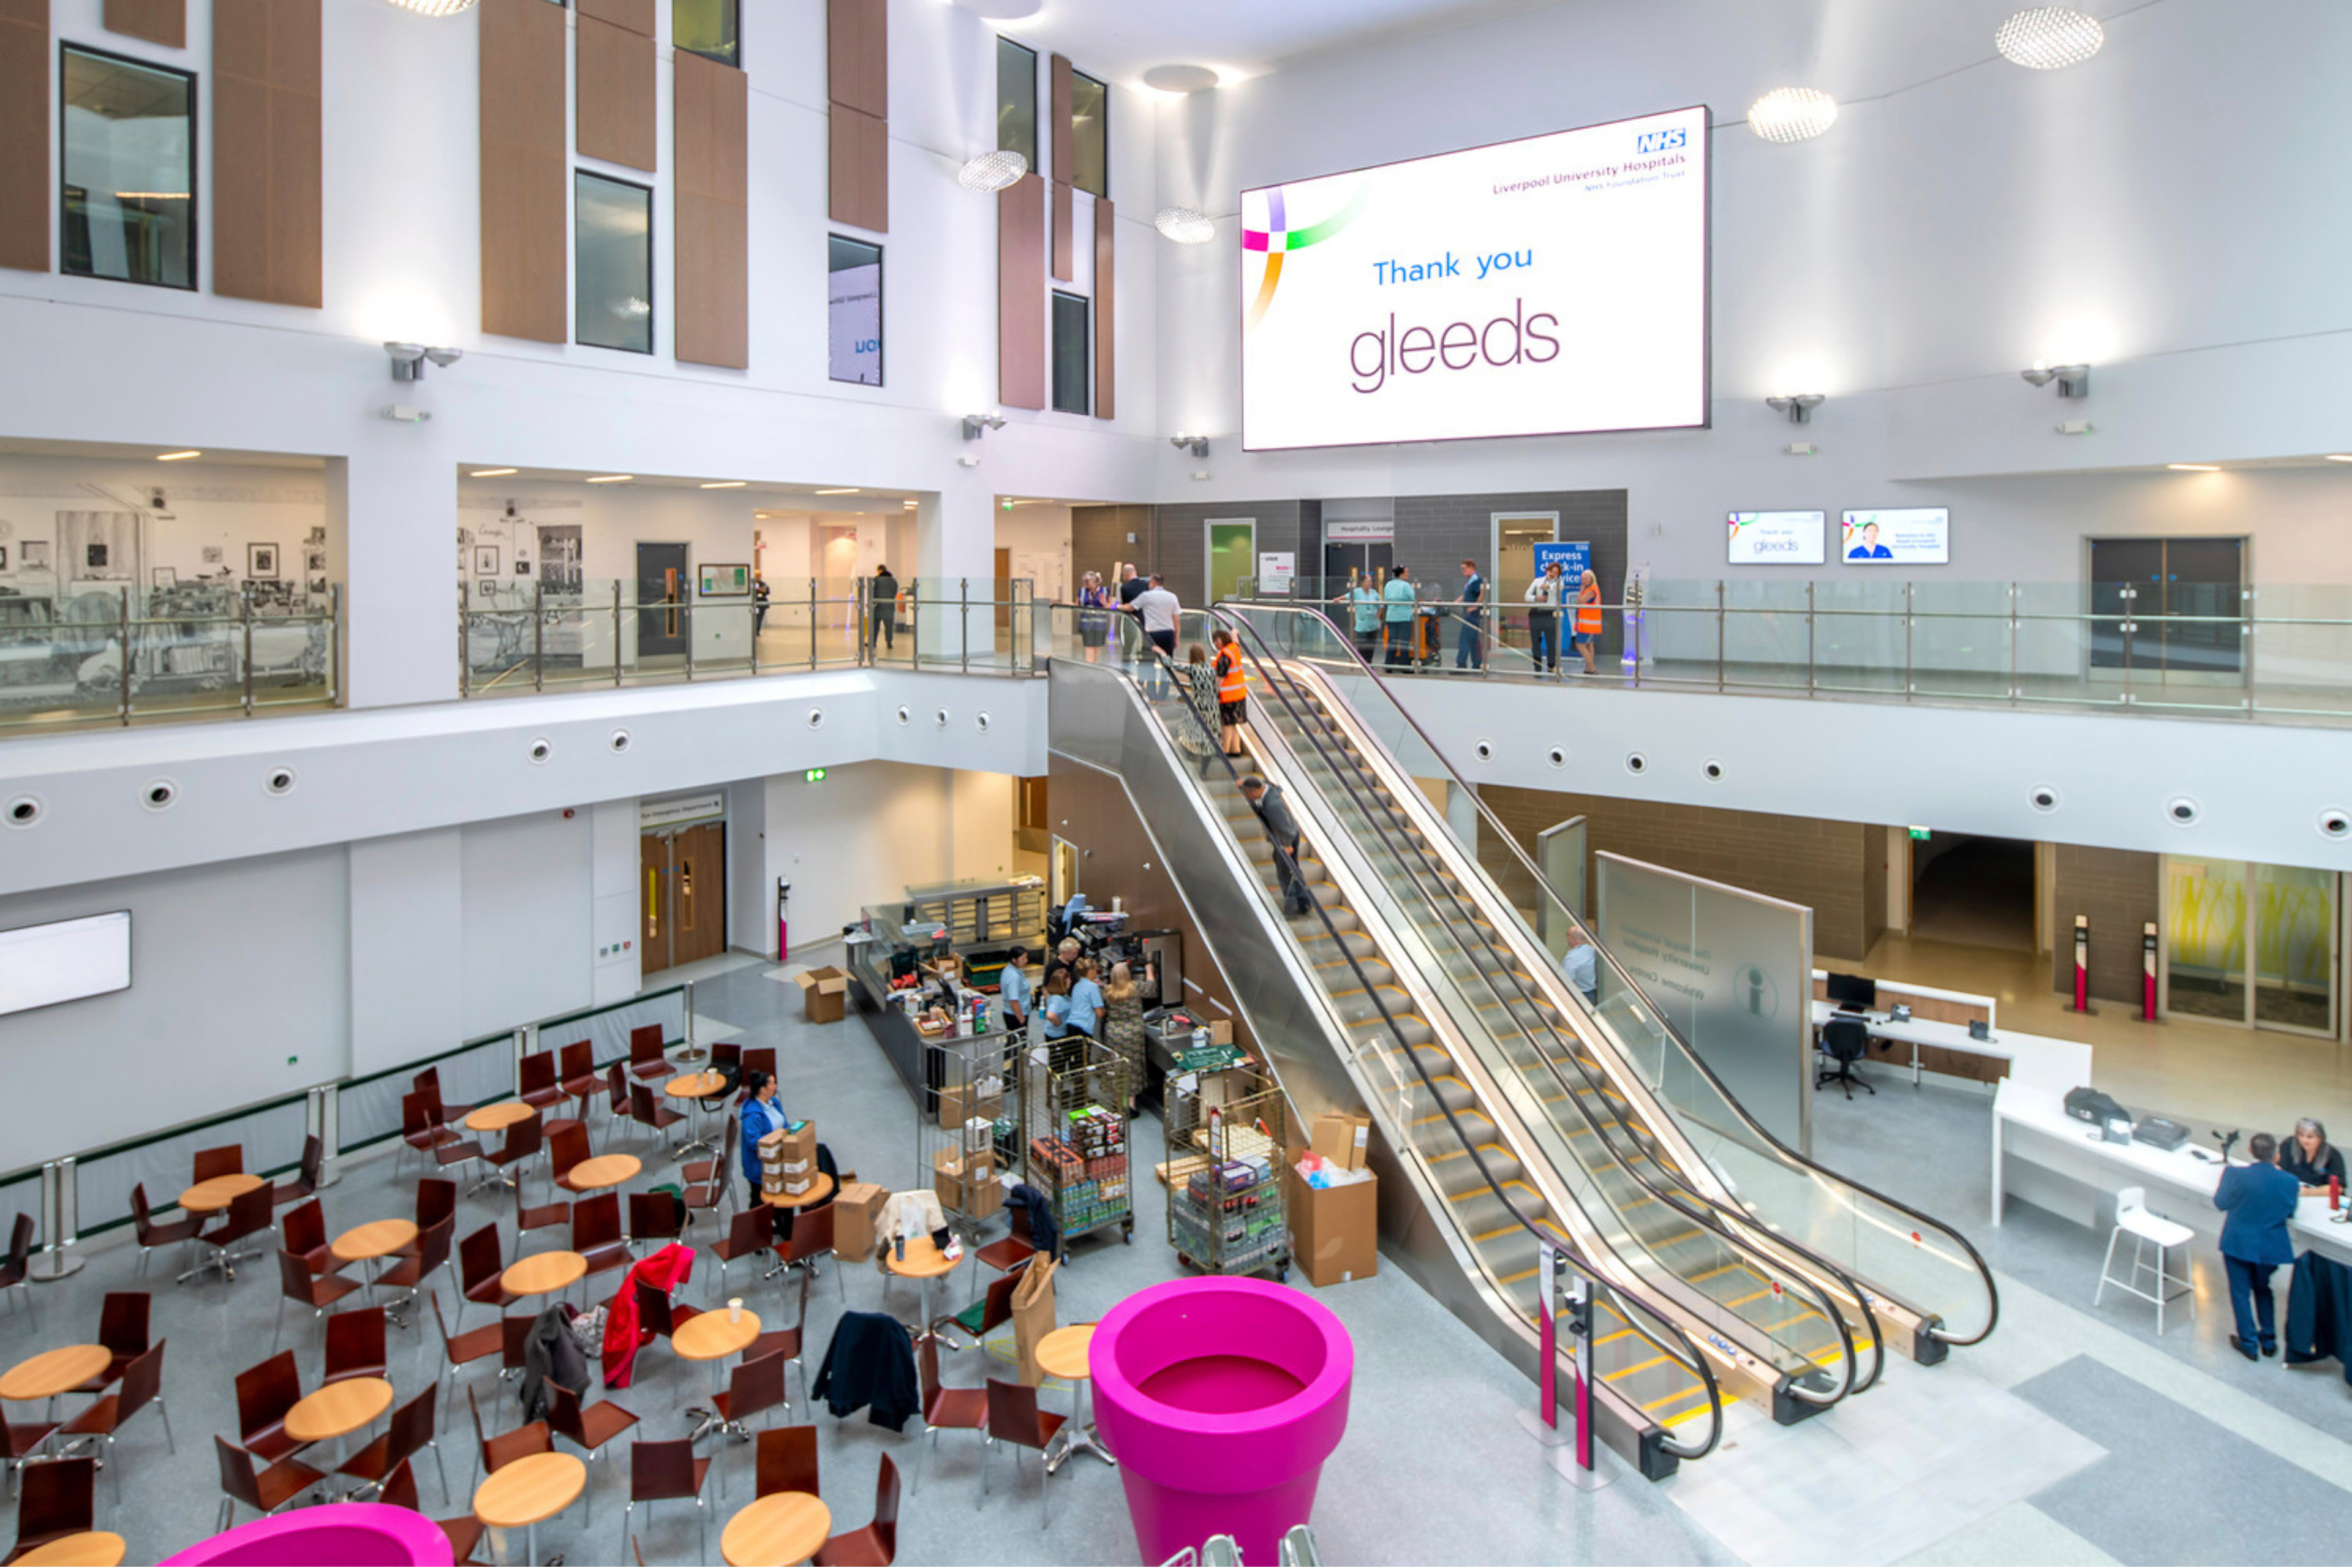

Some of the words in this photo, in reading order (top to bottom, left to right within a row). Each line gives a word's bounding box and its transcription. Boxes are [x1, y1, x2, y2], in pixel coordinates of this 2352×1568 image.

[1638, 129, 1686, 153] NHS
[1493, 175, 1550, 195] Liverpool
[1553, 165, 1619, 185] University
[1623, 153, 1686, 173] Hospitals
[1373, 251, 1461, 286] Thank
[1476, 249, 1532, 280] you
[1350, 297, 1560, 394] gleeds
[1542, 550, 1582, 562] Express
[1754, 538, 1799, 555] gleeds
[1540, 562, 1584, 571] ck-in
